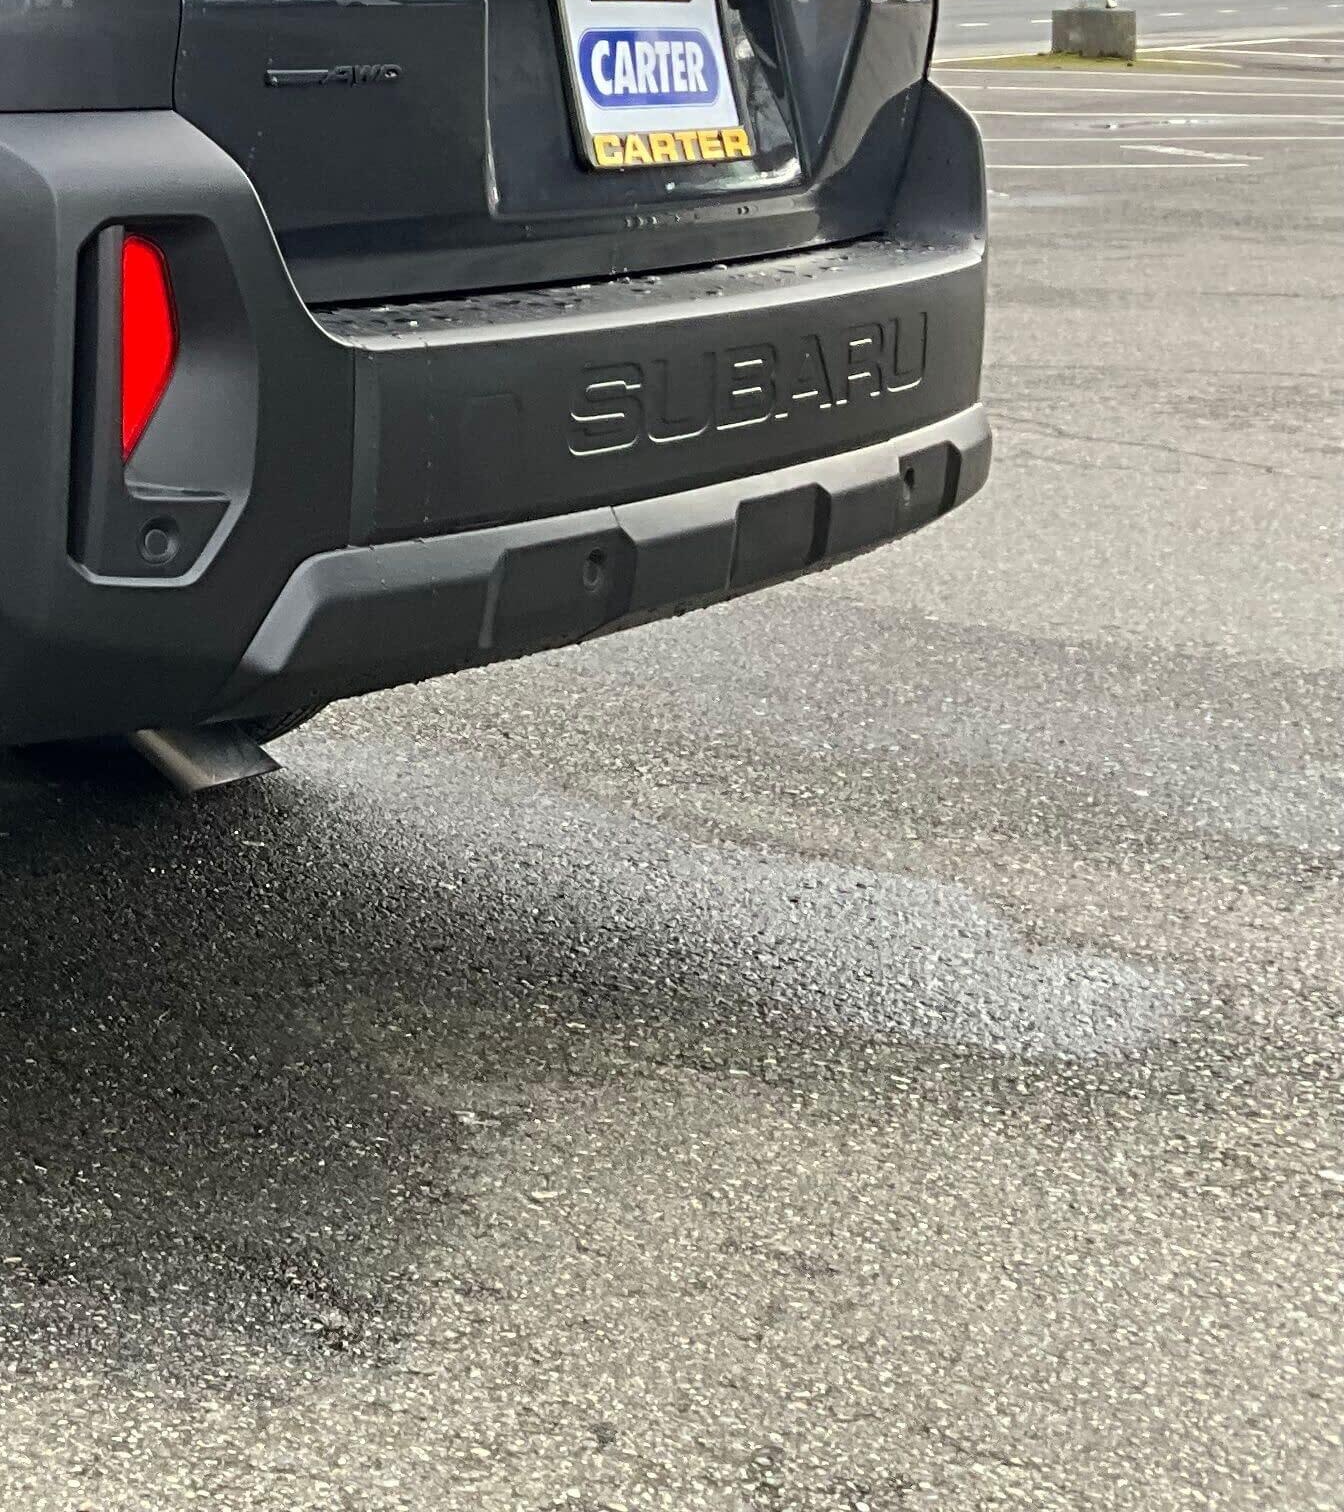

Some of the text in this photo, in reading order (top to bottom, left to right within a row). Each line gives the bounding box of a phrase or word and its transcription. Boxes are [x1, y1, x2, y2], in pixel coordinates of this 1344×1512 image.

[590, 38, 709, 96] CARTER
[592, 128, 751, 166] CARTER
[567, 311, 928, 456] SUBARU
